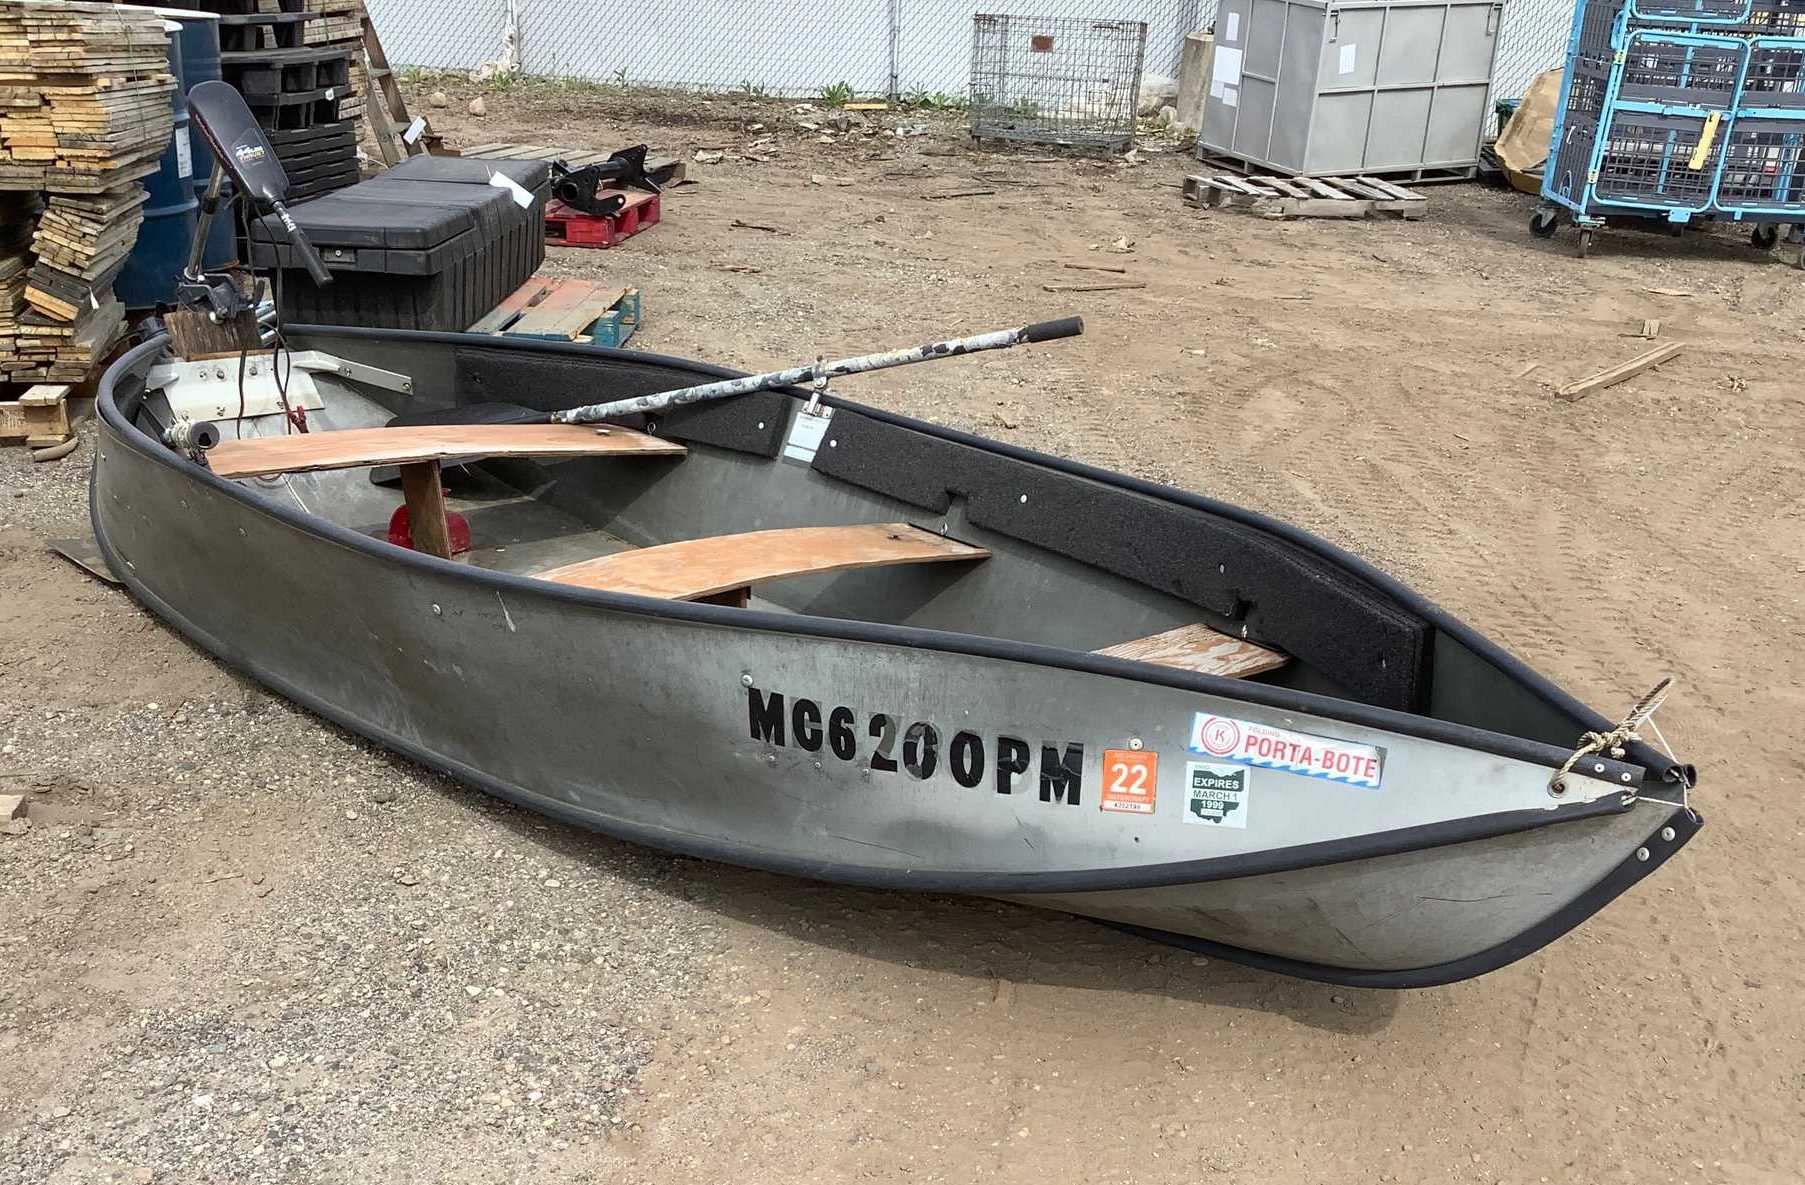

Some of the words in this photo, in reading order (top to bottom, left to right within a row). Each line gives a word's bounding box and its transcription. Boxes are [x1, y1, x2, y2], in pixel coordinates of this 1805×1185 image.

[1215, 729, 1225, 742] K
[1244, 734, 1378, 778] PORTA-BOTE
[1111, 763, 1147, 795] 22
[1194, 777, 1240, 790] EXPIRES
[1193, 789, 1230, 801] MARCH
[1233, 793, 1238, 801] 1
[1201, 800, 1224, 810] 1999
